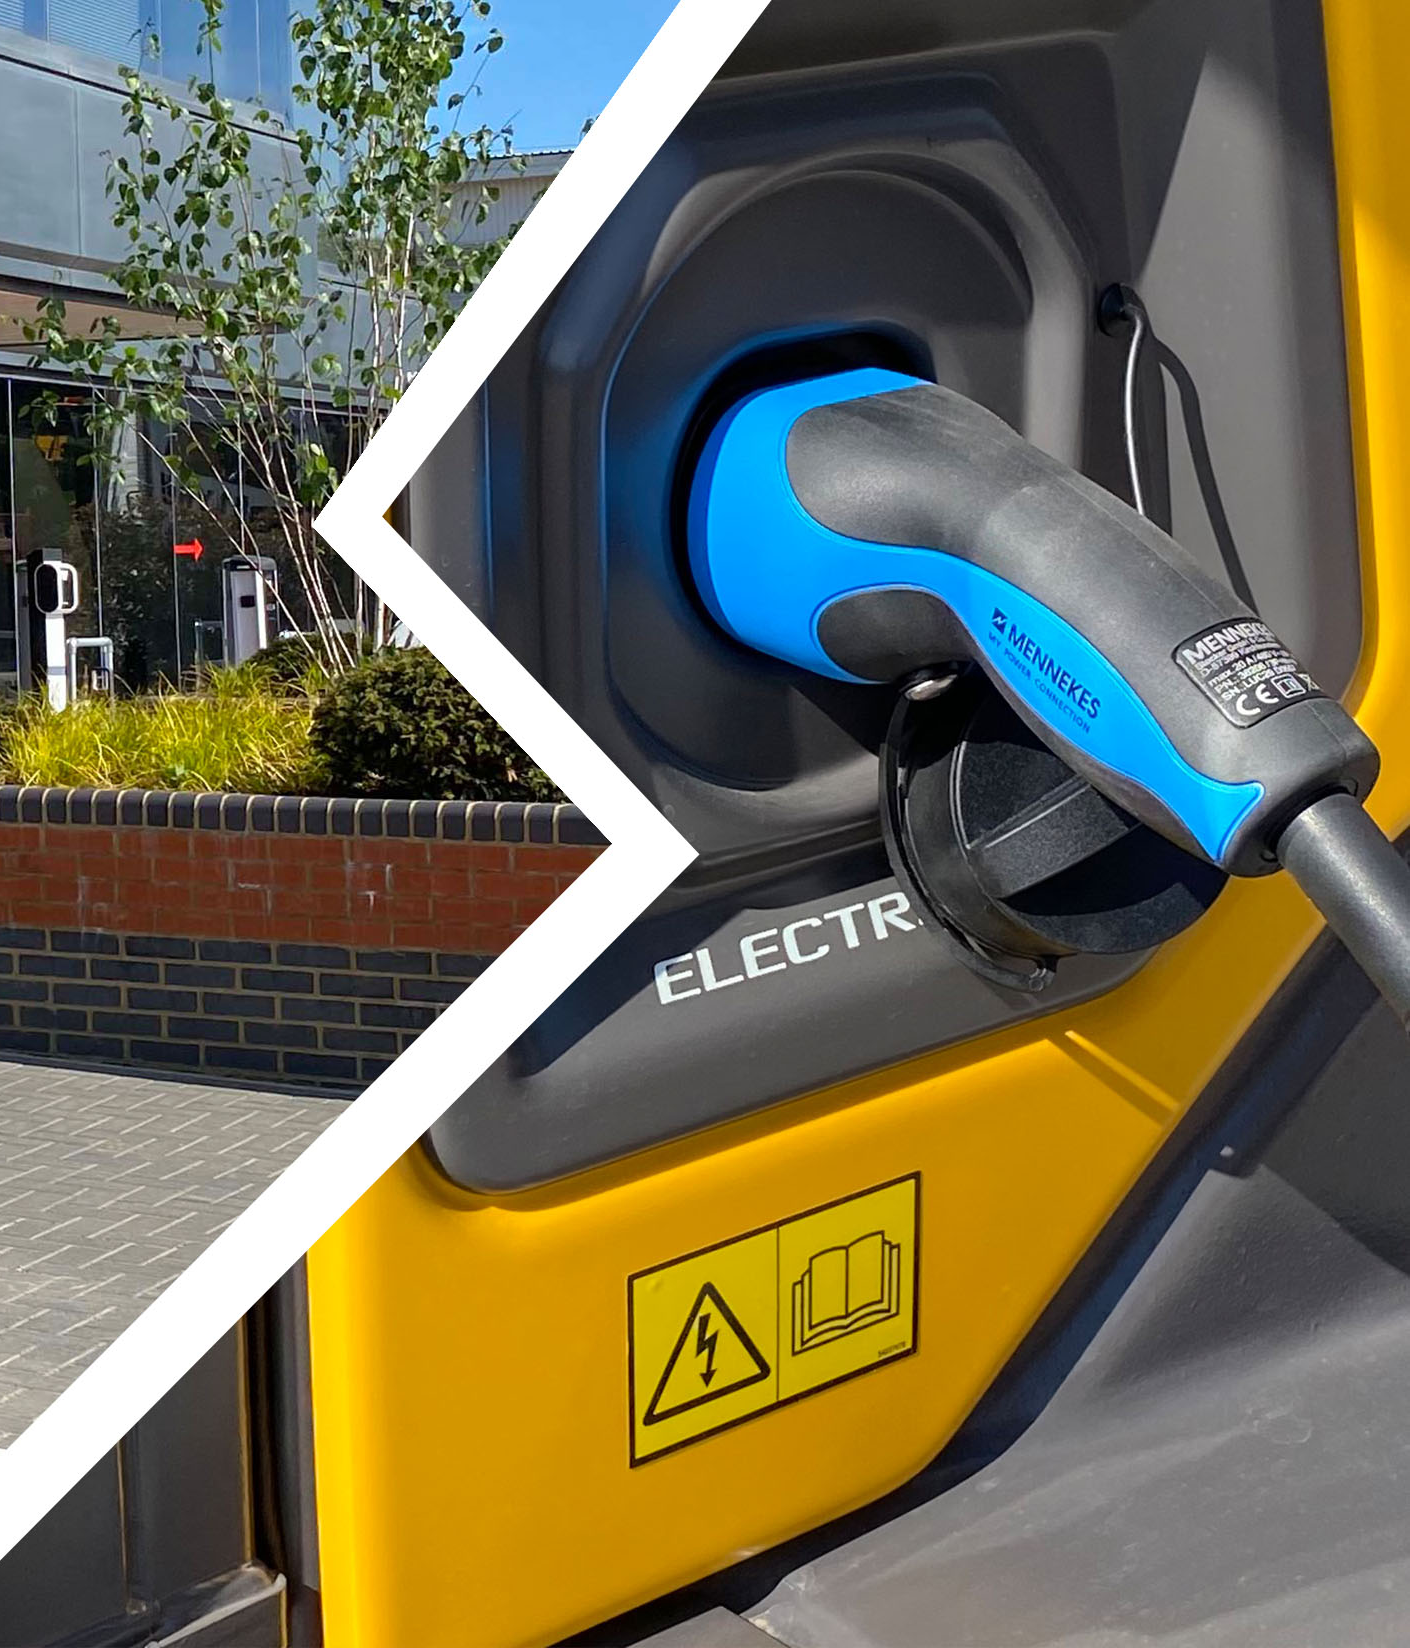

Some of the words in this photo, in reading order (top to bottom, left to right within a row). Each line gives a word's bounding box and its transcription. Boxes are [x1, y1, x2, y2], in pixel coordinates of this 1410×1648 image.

[1008, 623, 1101, 719] MENNEKES
[1034, 678, 1091, 734] CONNECTION
[654, 891, 924, 1005] ELECTR
